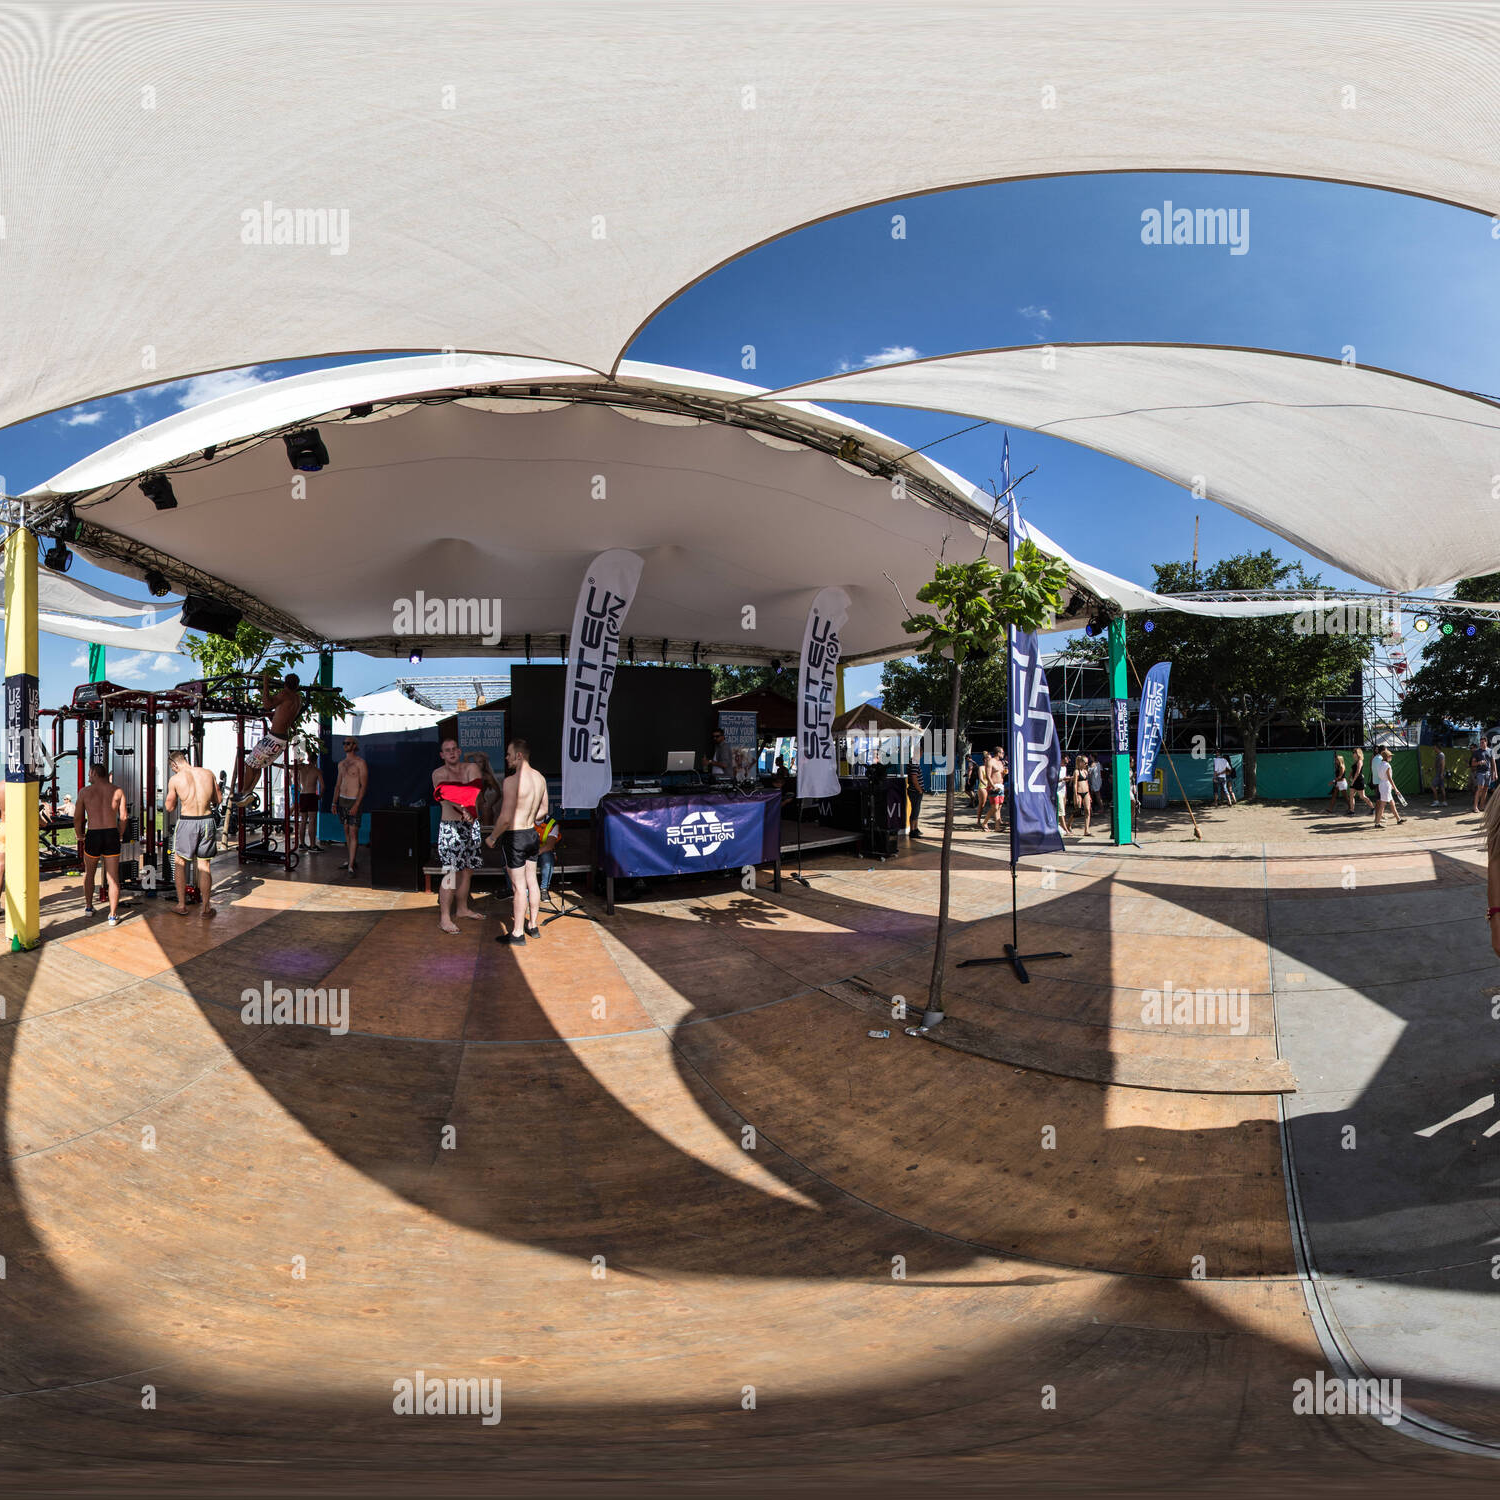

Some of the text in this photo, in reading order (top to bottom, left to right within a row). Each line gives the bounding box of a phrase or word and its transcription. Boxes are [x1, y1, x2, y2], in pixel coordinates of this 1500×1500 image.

[8, 688, 16, 773] SCITEC
[460, 728, 501, 738] ENJOY YOUR
[725, 727, 755, 735] NJOY YOUR
[1117, 702, 1125, 752] SCITEC
[1145, 683, 1165, 775] NUTRITION
[460, 738, 481, 747] BEACH
[725, 735, 739, 743] EACH
[666, 822, 734, 837] SCITEC
[667, 832, 735, 846] NUTRITION
